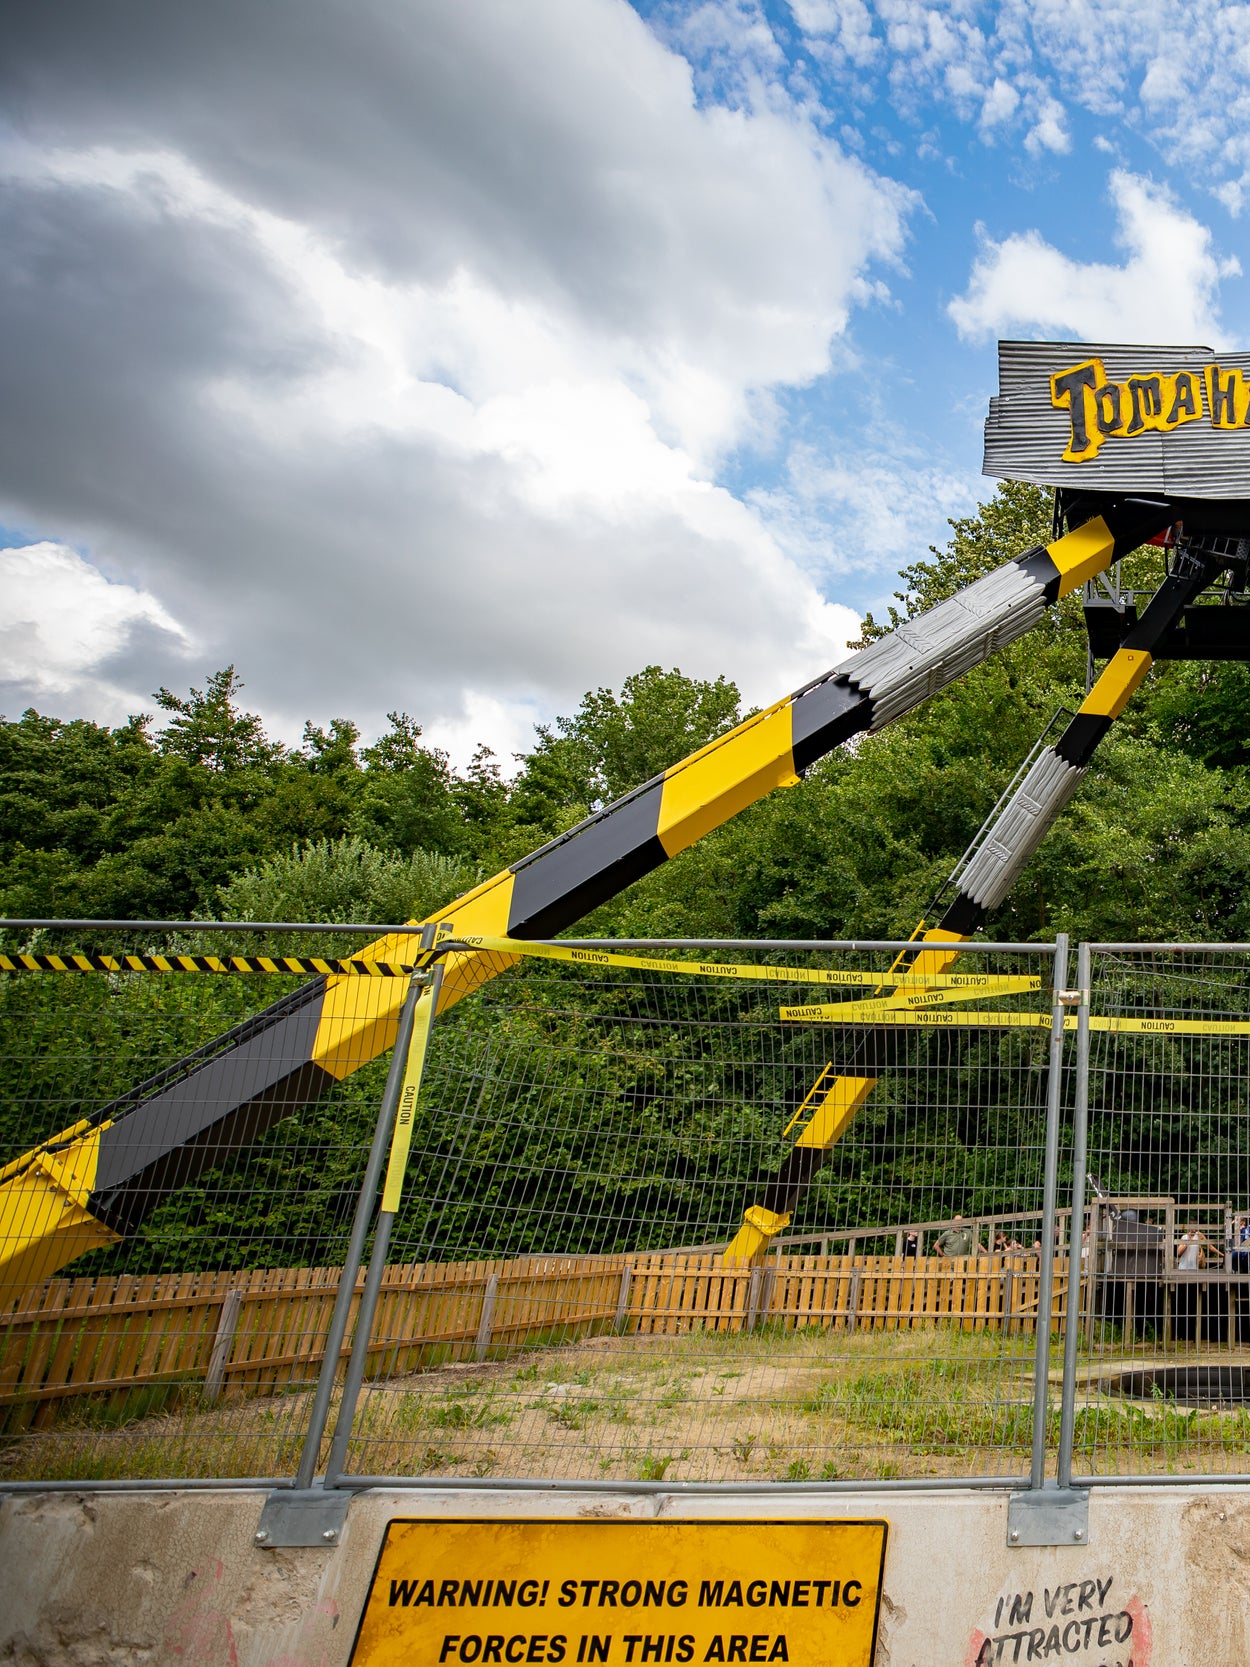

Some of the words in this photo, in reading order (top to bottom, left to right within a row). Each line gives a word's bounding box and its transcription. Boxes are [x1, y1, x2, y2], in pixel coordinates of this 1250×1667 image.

[572, 951, 609, 963] CAUTION
[700, 965, 738, 975] CAUTION
[826, 973, 863, 982] CAUTION
[951, 976, 987, 985] CAUTION
[908, 993, 944, 1005] CAUTION
[786, 1007, 822, 1018] CAUTION
[917, 1014, 953, 1022] CAUTION
[1141, 1021, 1175, 1031] CAUTION
[400, 1085, 416, 1125] CAUTION
[388, 1579, 550, 1608] WARNING!
[557, 1579, 688, 1608] STRONG
[698, 1579, 862, 1608] MAGNETIC
[994, 1591, 1033, 1629] I'M
[1044, 1576, 1113, 1619] VERY
[975, 1610, 1134, 1667] ATTRACTED
[438, 1634, 567, 1664] FORCES
[576, 1634, 608, 1663] IN
[622, 1634, 695, 1664] THIS
[703, 1634, 790, 1663] AREA
